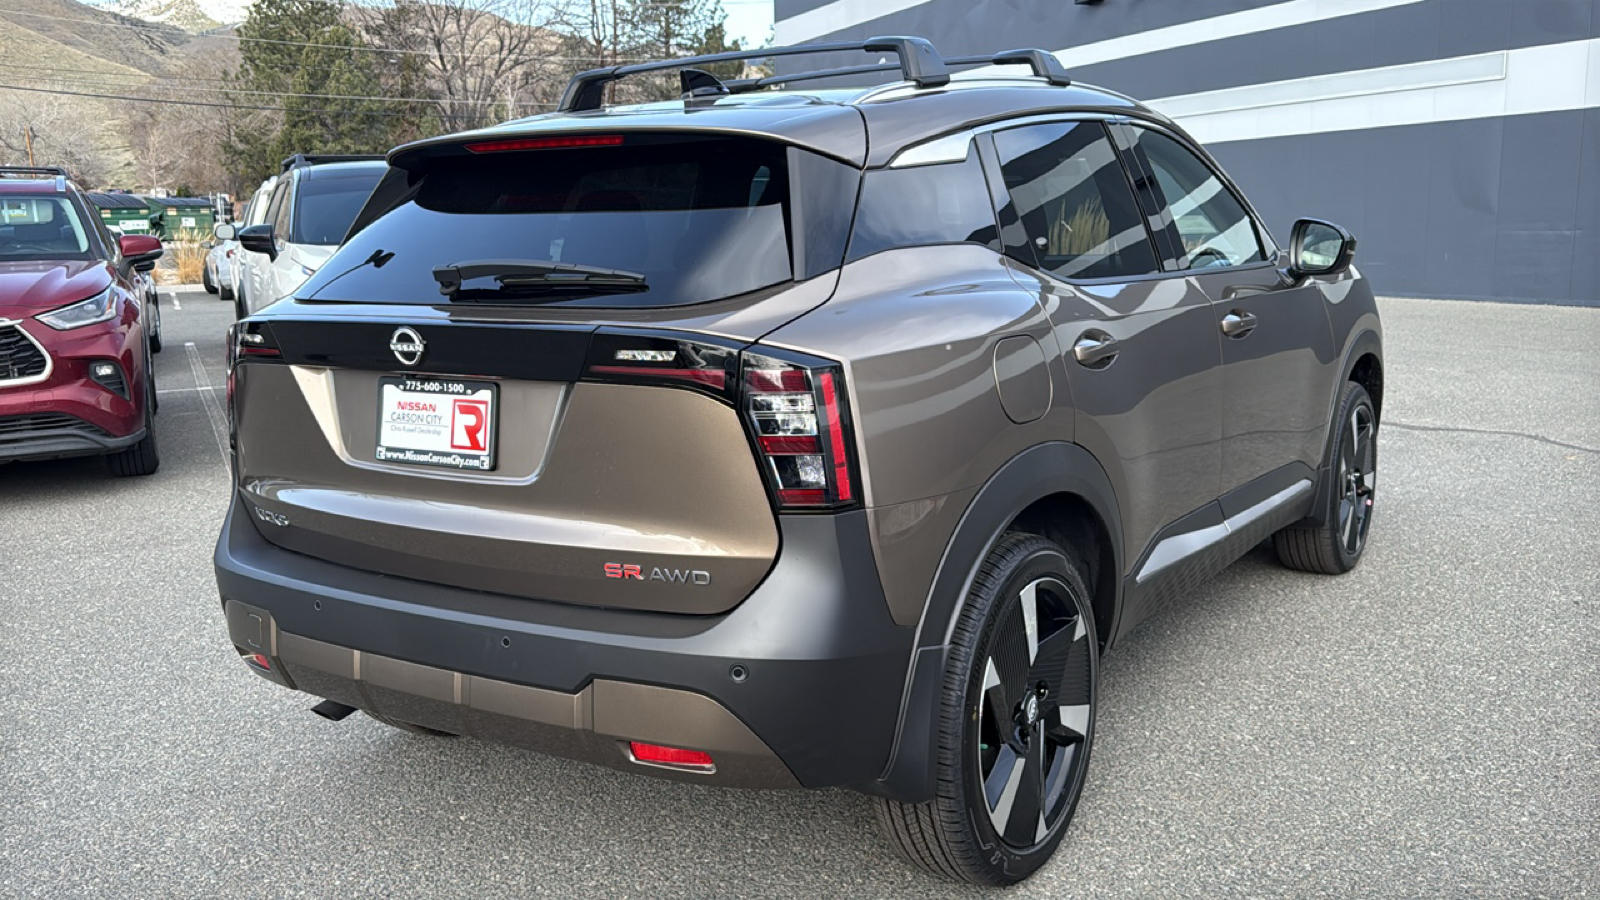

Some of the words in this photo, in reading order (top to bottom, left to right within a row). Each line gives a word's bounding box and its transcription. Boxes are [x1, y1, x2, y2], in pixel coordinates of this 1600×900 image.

[405, 380, 465, 393] 775-600-1500
[397, 400, 437, 412] NISSAN
[390, 411, 424, 423] CARSON
[425, 414, 443, 425] CITY
[385, 450, 480, 468] www.NissanCarsonCity.com
[604, 562, 645, 580] SR
[650, 567, 711, 585] AWD
